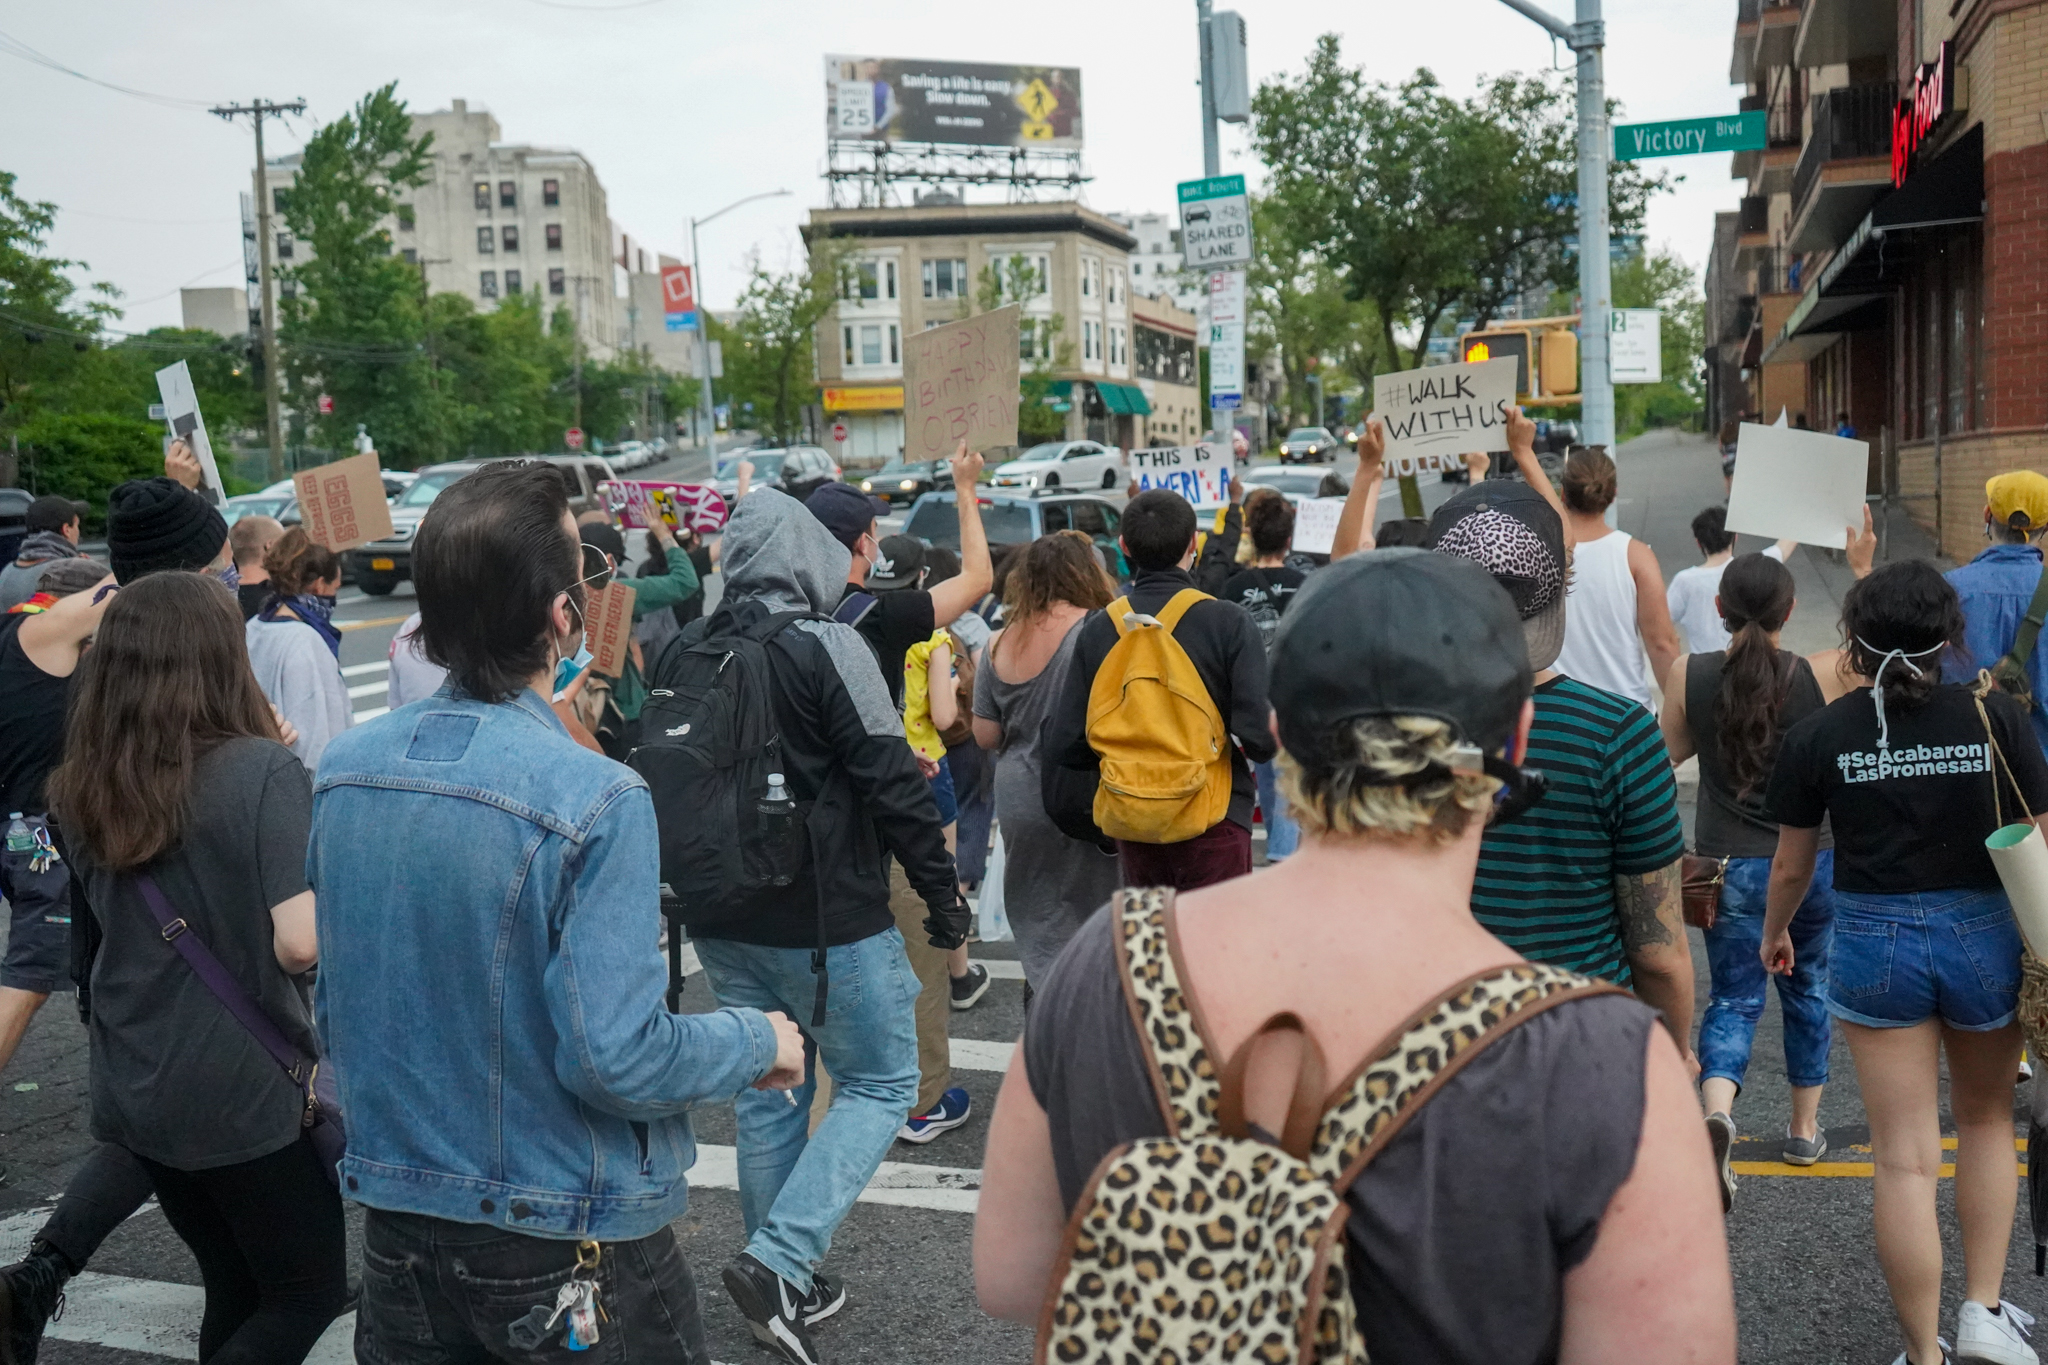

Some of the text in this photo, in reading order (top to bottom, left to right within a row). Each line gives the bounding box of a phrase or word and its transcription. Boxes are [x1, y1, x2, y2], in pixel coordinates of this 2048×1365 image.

[901, 73, 941, 91] Saving
[925, 90, 954, 104] Slow
[1912, 40, 1944, 153] Food
[842, 108, 871, 126] 25
[1633, 120, 1743, 153] Victory Blvd
[1187, 224, 1245, 244] SHARED
[1199, 242, 1236, 259] LANE
[921, 321, 987, 374] HAPPY
[1381, 374, 1476, 408] #WALK
[922, 394, 1011, 452] O'BRIEN
[1134, 446, 1210, 467] THIS IS
[323, 474, 360, 543] EGGS
[600, 645, 615, 669] KEEP
[1837, 743, 1982, 769] #SeAcabaron
[1843, 759, 1983, 783] LasPromesas
